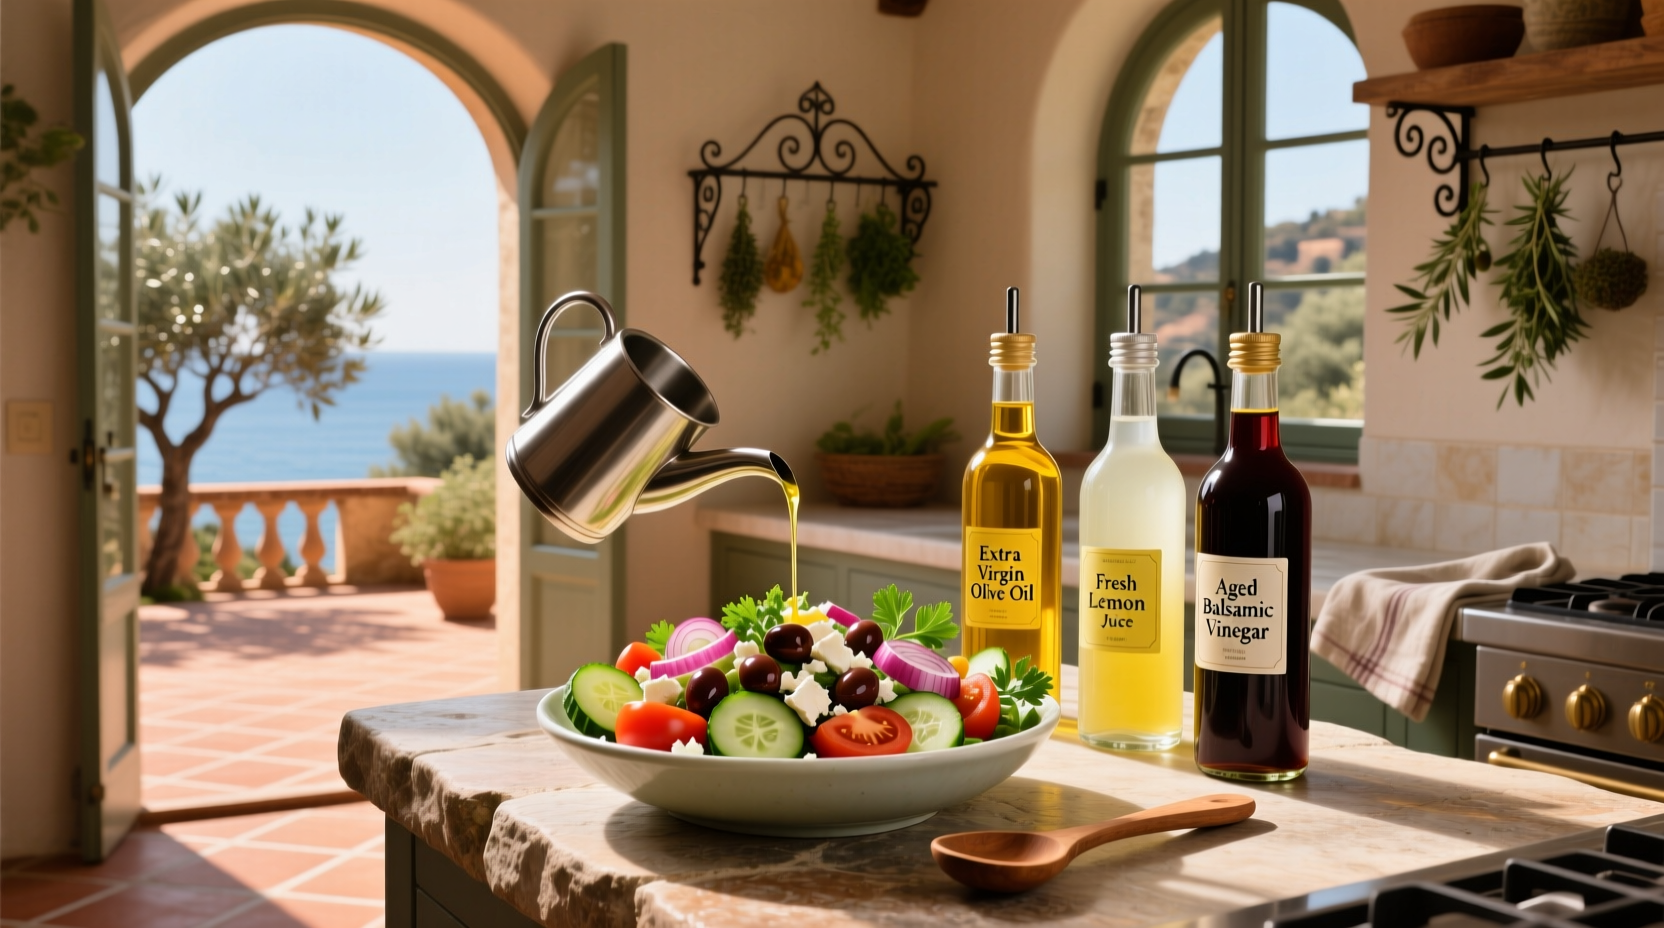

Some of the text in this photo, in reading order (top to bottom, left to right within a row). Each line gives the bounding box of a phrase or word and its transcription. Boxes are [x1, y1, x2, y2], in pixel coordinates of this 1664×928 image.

[979, 545, 1021, 562] Extra
[977, 565, 1025, 586] Virgin
[1096, 573, 1137, 592] Fresh
[1009, 584, 1034, 601] Oil
[1215, 577, 1258, 601] Aged
[1089, 591, 1146, 611] Lemon
[1203, 597, 1274, 618] Balsamic
[1206, 618, 1270, 645] Vinegar
